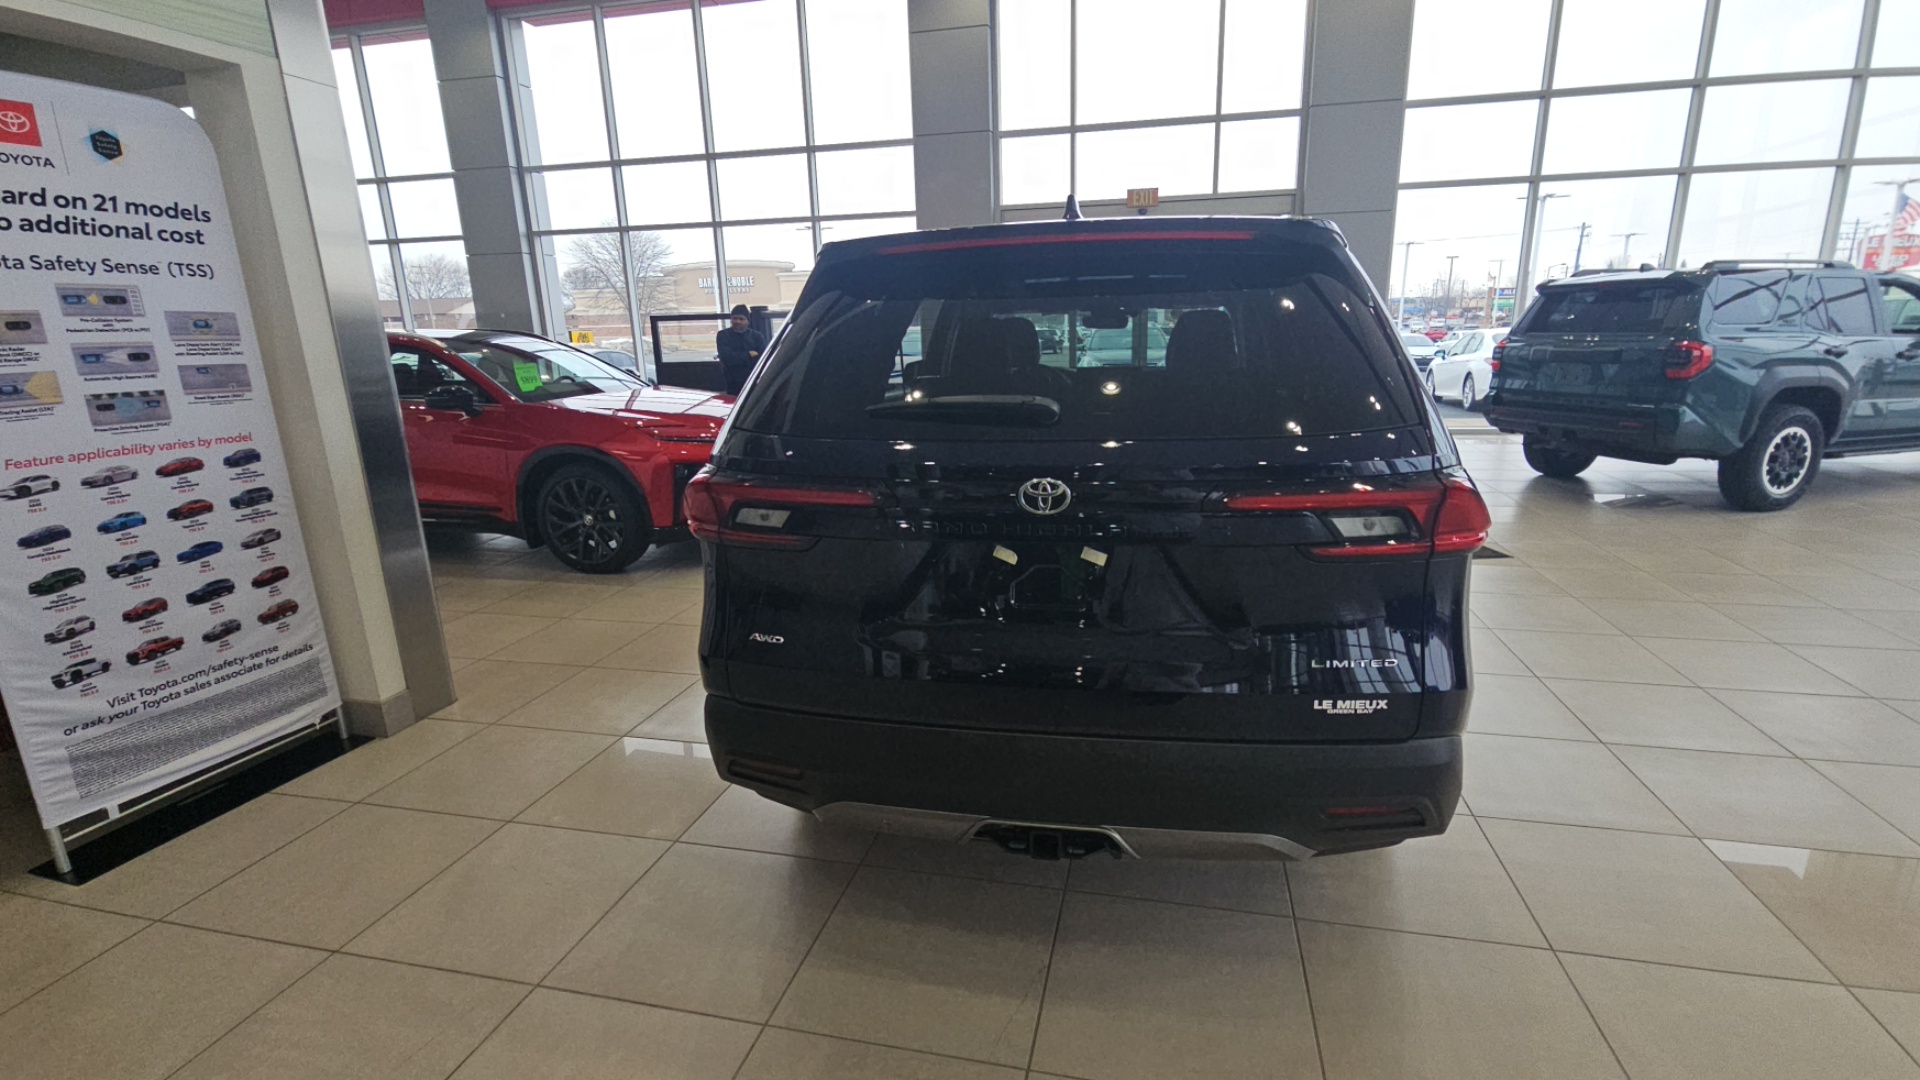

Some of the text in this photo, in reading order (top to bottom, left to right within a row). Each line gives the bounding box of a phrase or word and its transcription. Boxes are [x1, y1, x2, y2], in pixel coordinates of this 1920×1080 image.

[1, 187, 211, 223] ard on 21 models
[1133, 190, 1153, 206] EXIT
[19, 214, 153, 240] additional
[157, 228, 205, 245] cost
[0, 254, 214, 280] ta Safety Sense (TSS)
[4, 432, 252, 470] Feature applicability varies by model
[749, 633, 784, 644] AWD
[107, 692, 136, 709] Visit
[138, 643, 279, 698] Toyota.com/safety-sense
[1311, 659, 1399, 668] LIMITED
[63, 643, 314, 738] or ask your Toyota sales associate for details
[1313, 699, 1388, 709] LE MIEUX
